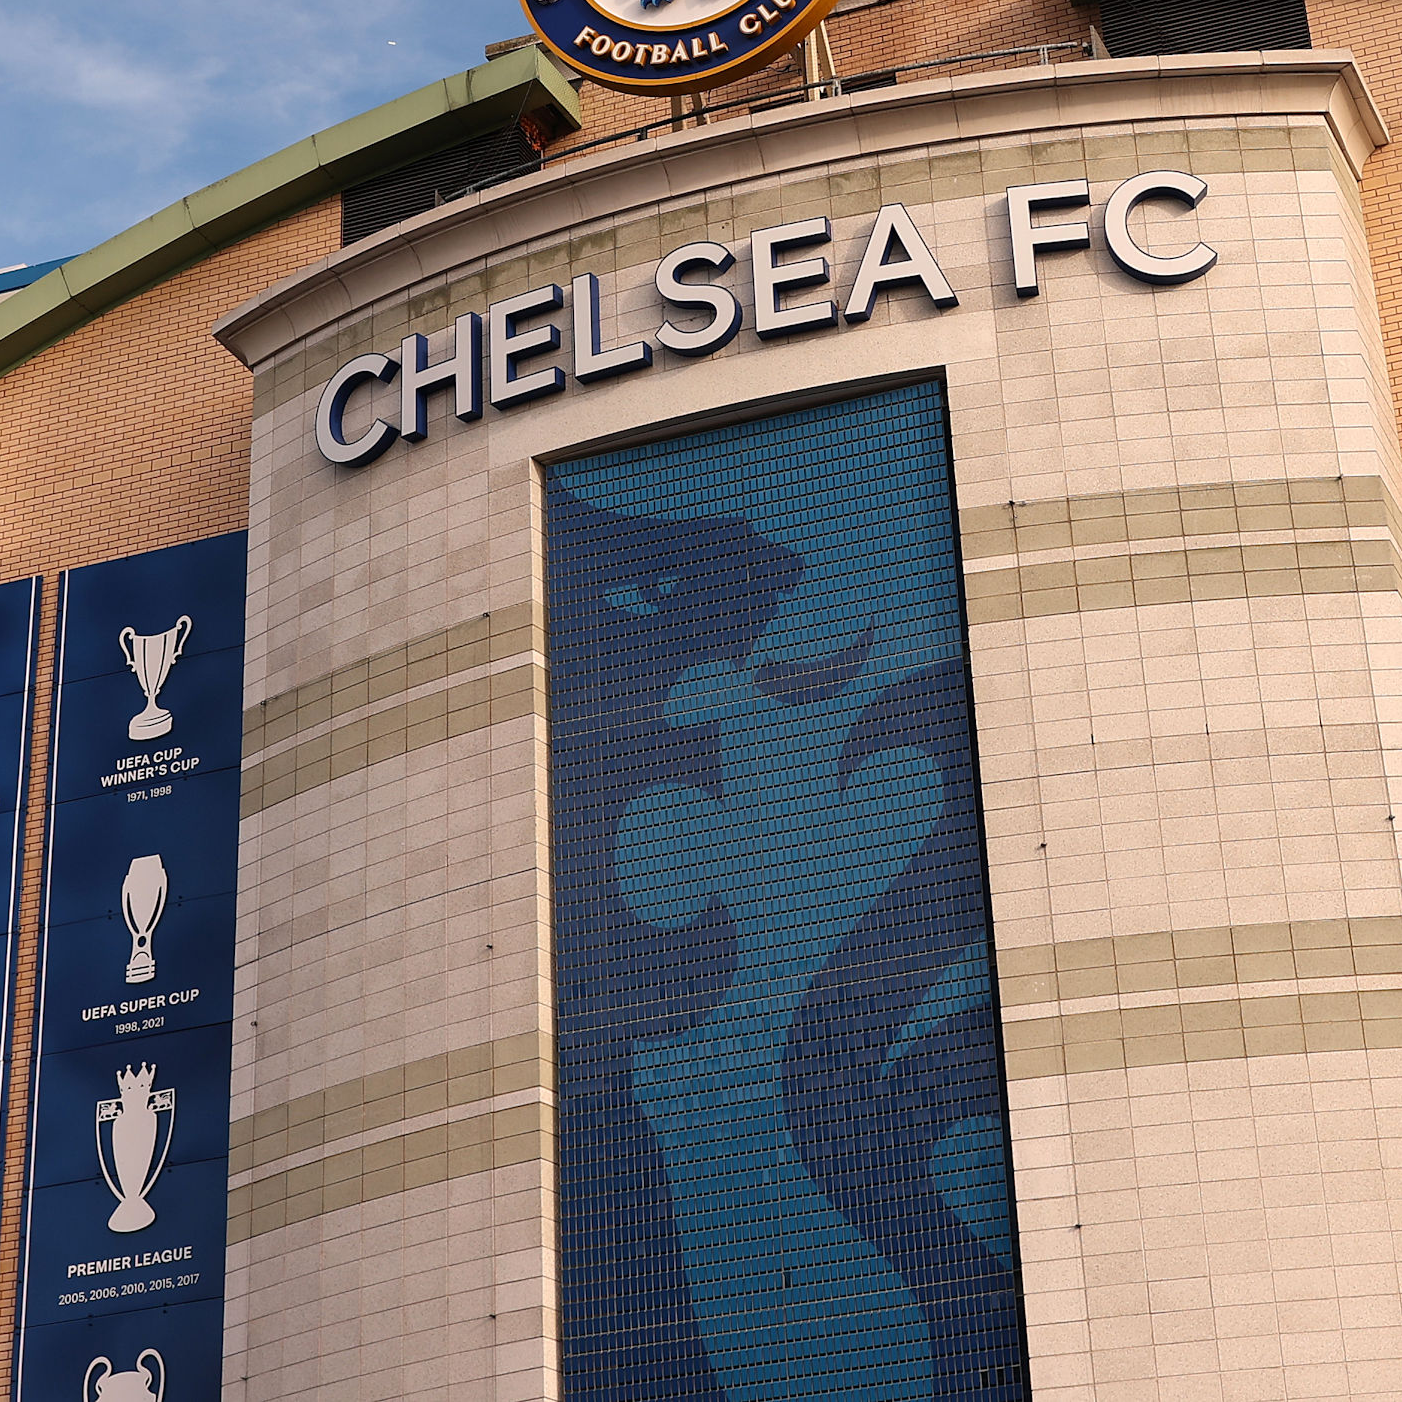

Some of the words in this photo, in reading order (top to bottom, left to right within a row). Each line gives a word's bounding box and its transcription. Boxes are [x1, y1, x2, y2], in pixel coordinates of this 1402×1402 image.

[573, 25, 729, 67] FOOTBALL
[314, 203, 959, 469] CHELSEA
[1006, 170, 1218, 299] FC
[100, 764, 168, 788] WINNER’S
[170, 757, 200, 774] CUP
[116, 754, 151, 771] UEFA
[153, 747, 183, 763] CUP
[126, 790, 148, 803] 1971,
[150, 785, 172, 798] 1998
[81, 1004, 117, 1021] UEFA
[119, 995, 166, 1015] SUPER
[168, 988, 200, 1005] CUP
[114, 1021, 141, 1034] 1998,
[141, 1016, 165, 1030] 2021
[67, 1255, 132, 1279] PREMIER
[134, 1245, 193, 1268] LEAGUE
[58, 1291, 88, 1305] 2005,
[89, 1286, 119, 1301] 2006,
[121, 1281, 147, 1296] 2010,
[149, 1278, 175, 1291] 2015,
[177, 1273, 200, 1287] 2017
